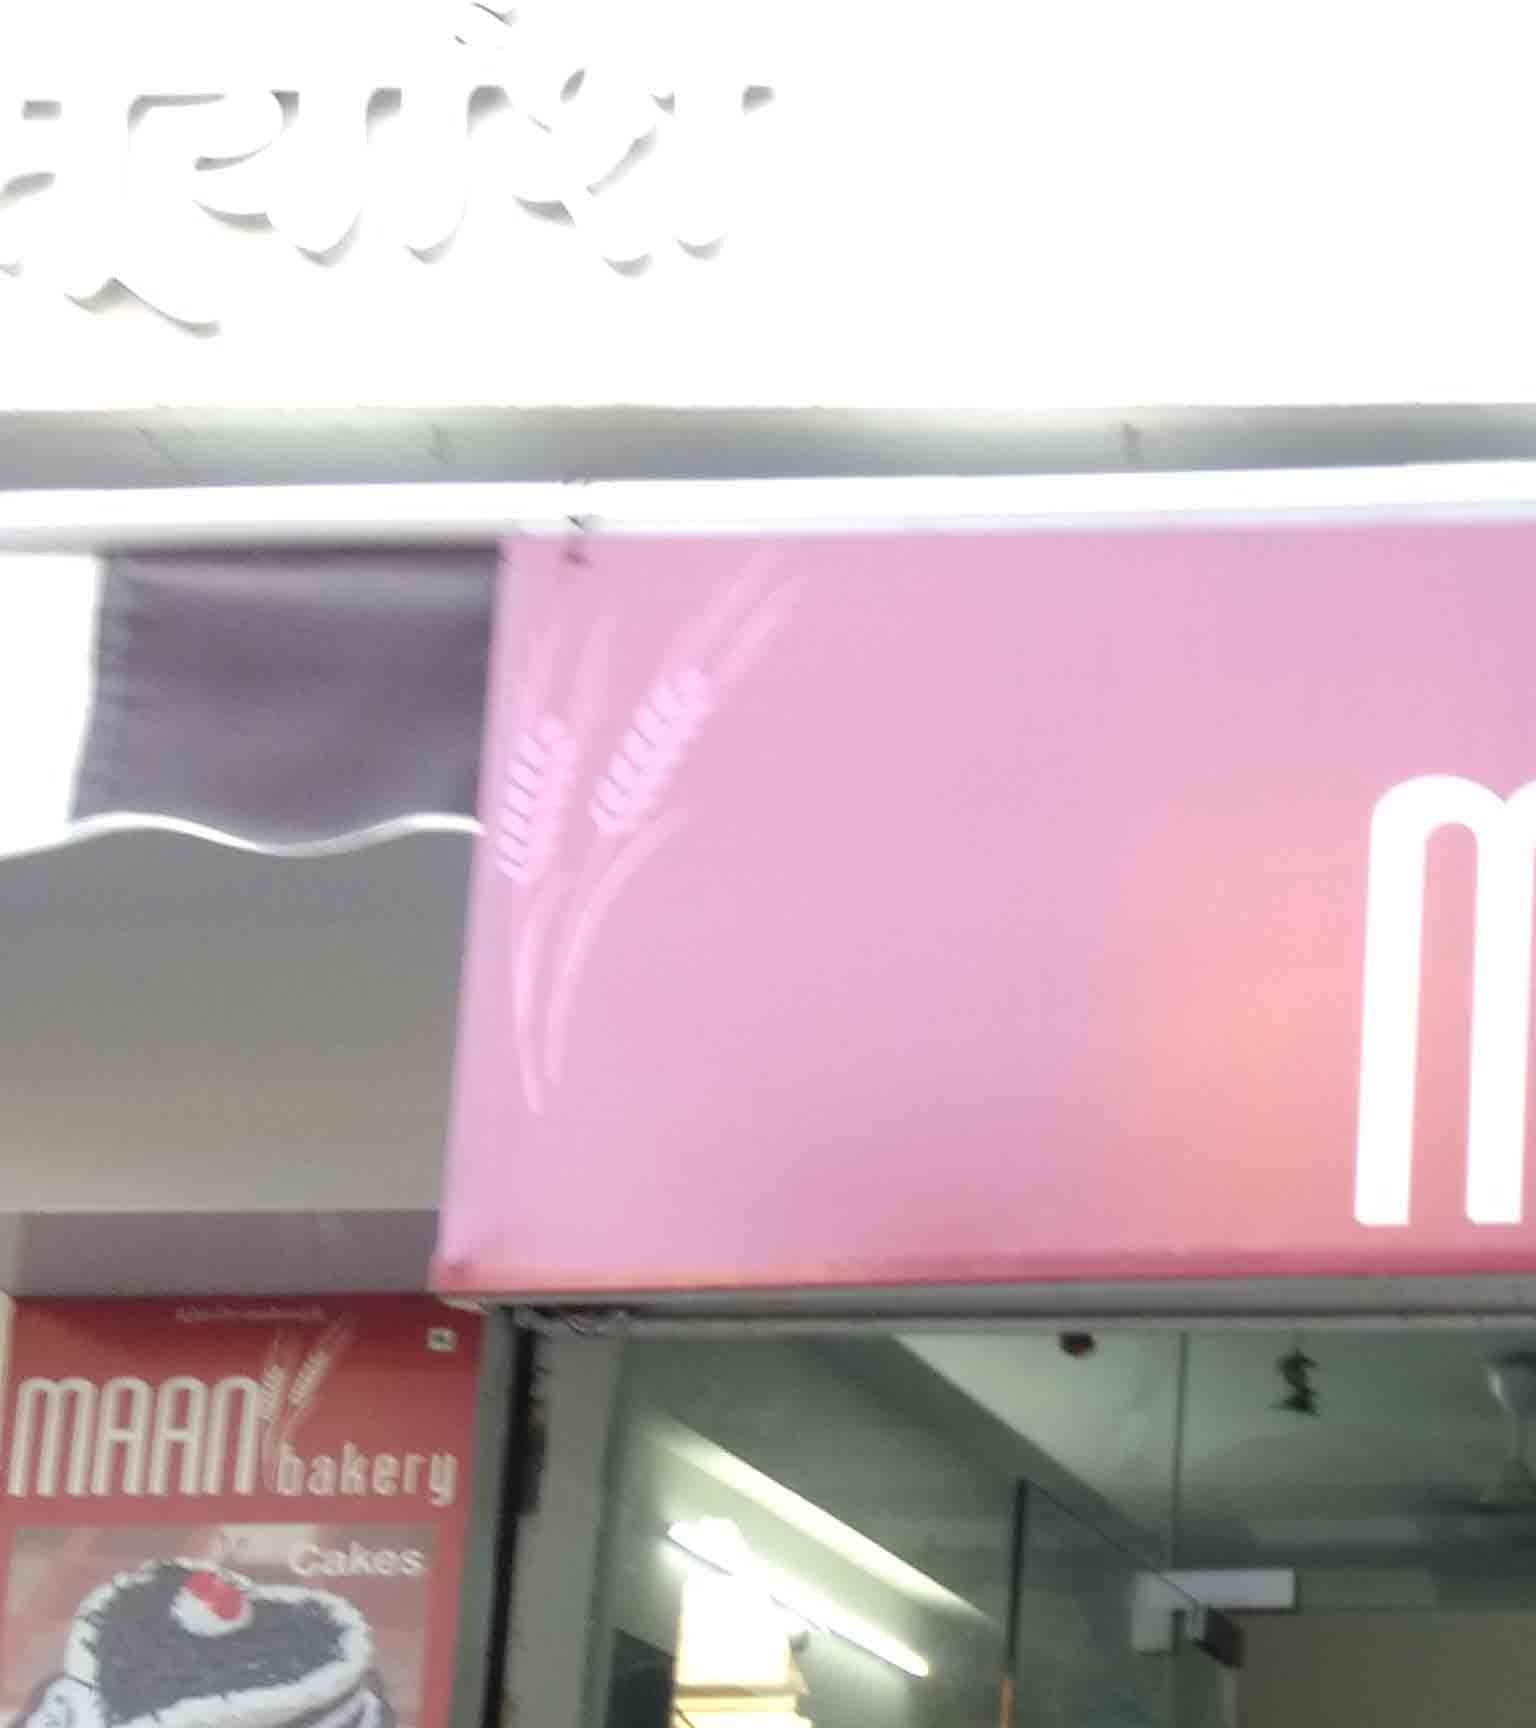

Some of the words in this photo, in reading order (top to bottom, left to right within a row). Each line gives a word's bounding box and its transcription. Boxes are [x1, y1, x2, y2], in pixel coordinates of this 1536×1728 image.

[4, 1376, 264, 1498] MAAN
[276, 1442, 458, 1505] bakery
[287, 1540, 427, 1578] Cakes
